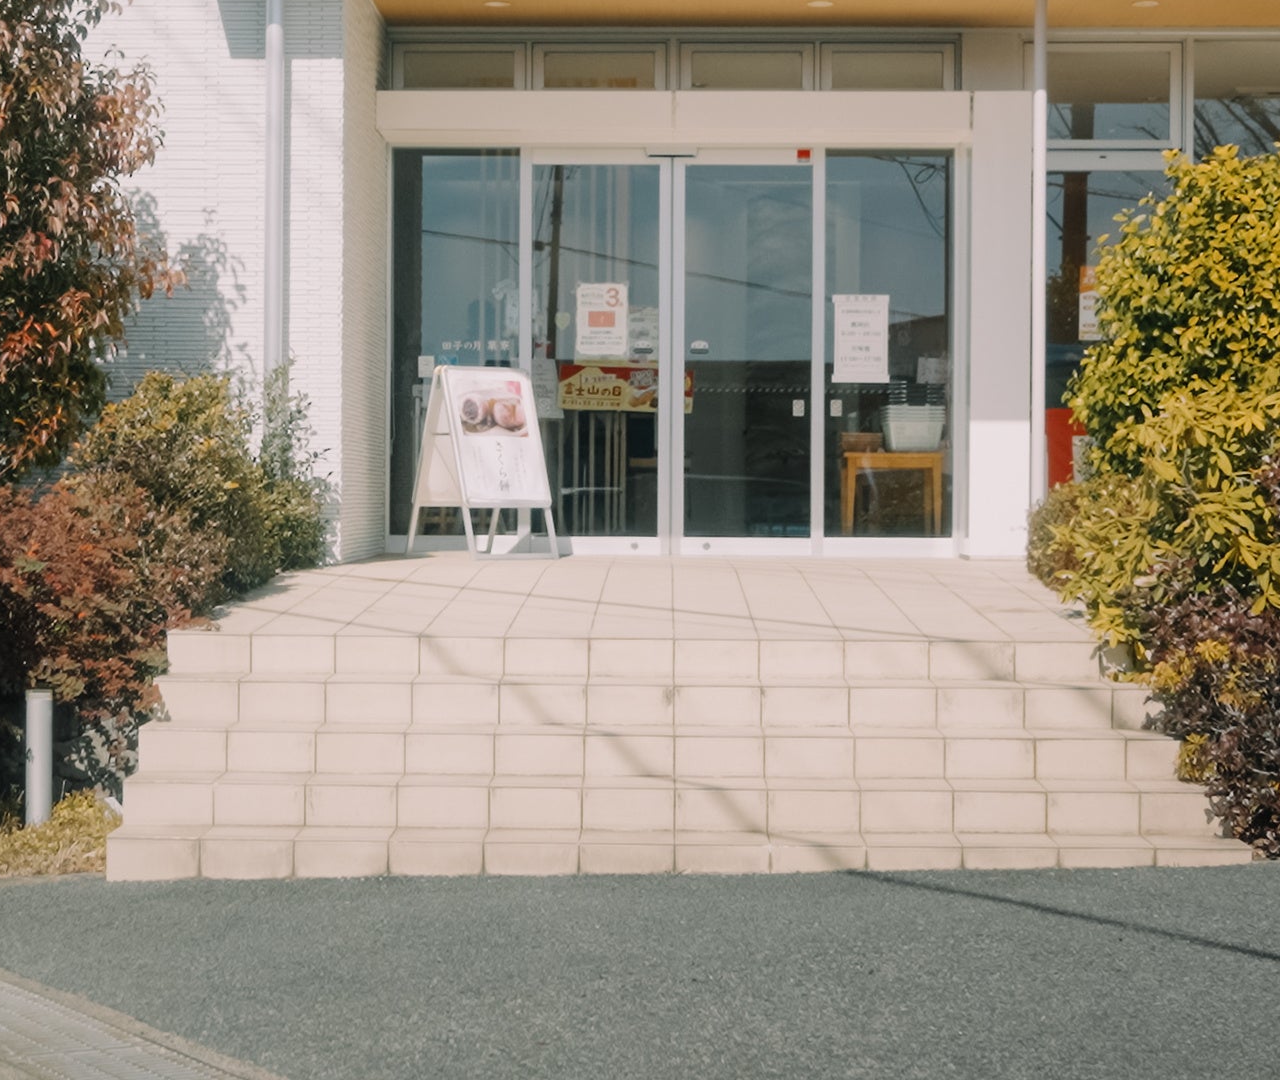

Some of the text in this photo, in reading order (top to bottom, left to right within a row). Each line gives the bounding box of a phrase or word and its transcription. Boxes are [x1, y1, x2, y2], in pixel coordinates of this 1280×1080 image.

[441, 340, 481, 352] 田子の月
[563, 374, 623, 397] 富士山の日
